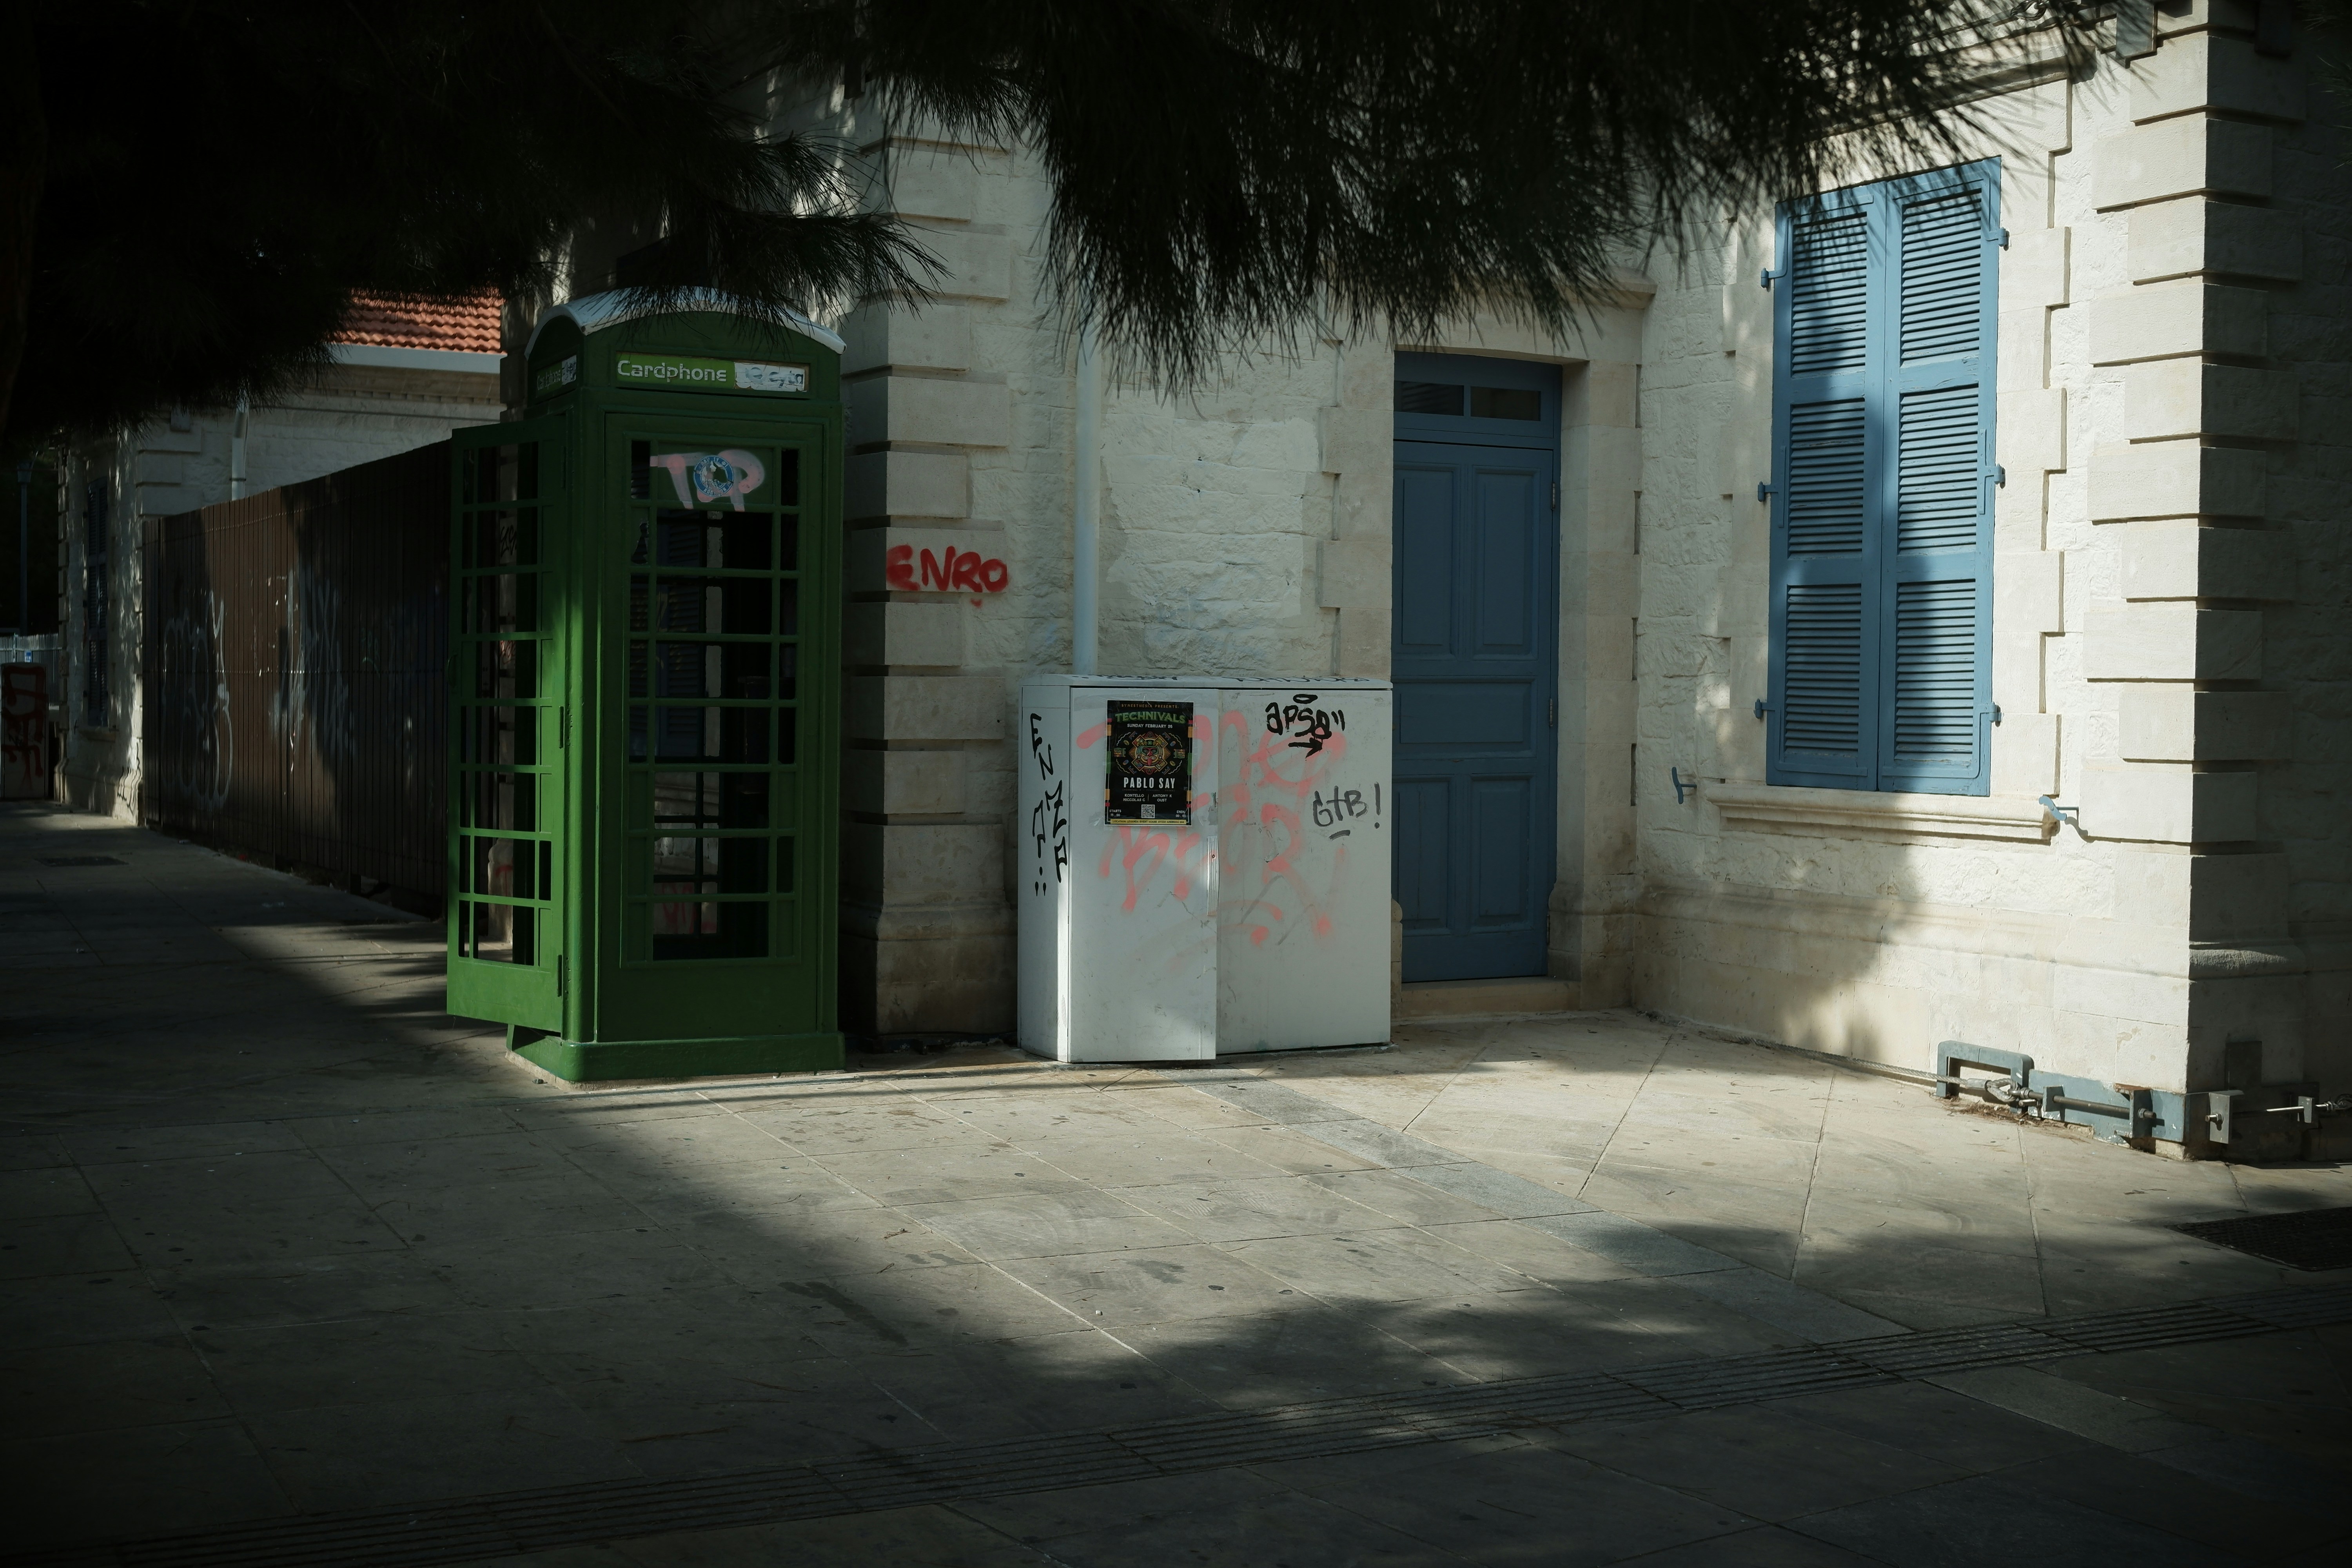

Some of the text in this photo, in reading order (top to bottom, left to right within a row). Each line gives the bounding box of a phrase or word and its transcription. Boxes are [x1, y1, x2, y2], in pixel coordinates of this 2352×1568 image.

[617, 360, 727, 382] Cardphone
[886, 544, 1008, 593] ENRO
[1115, 711, 1187, 724] TECHNIVALS
[1123, 777, 1175, 789] PABLO SAY
